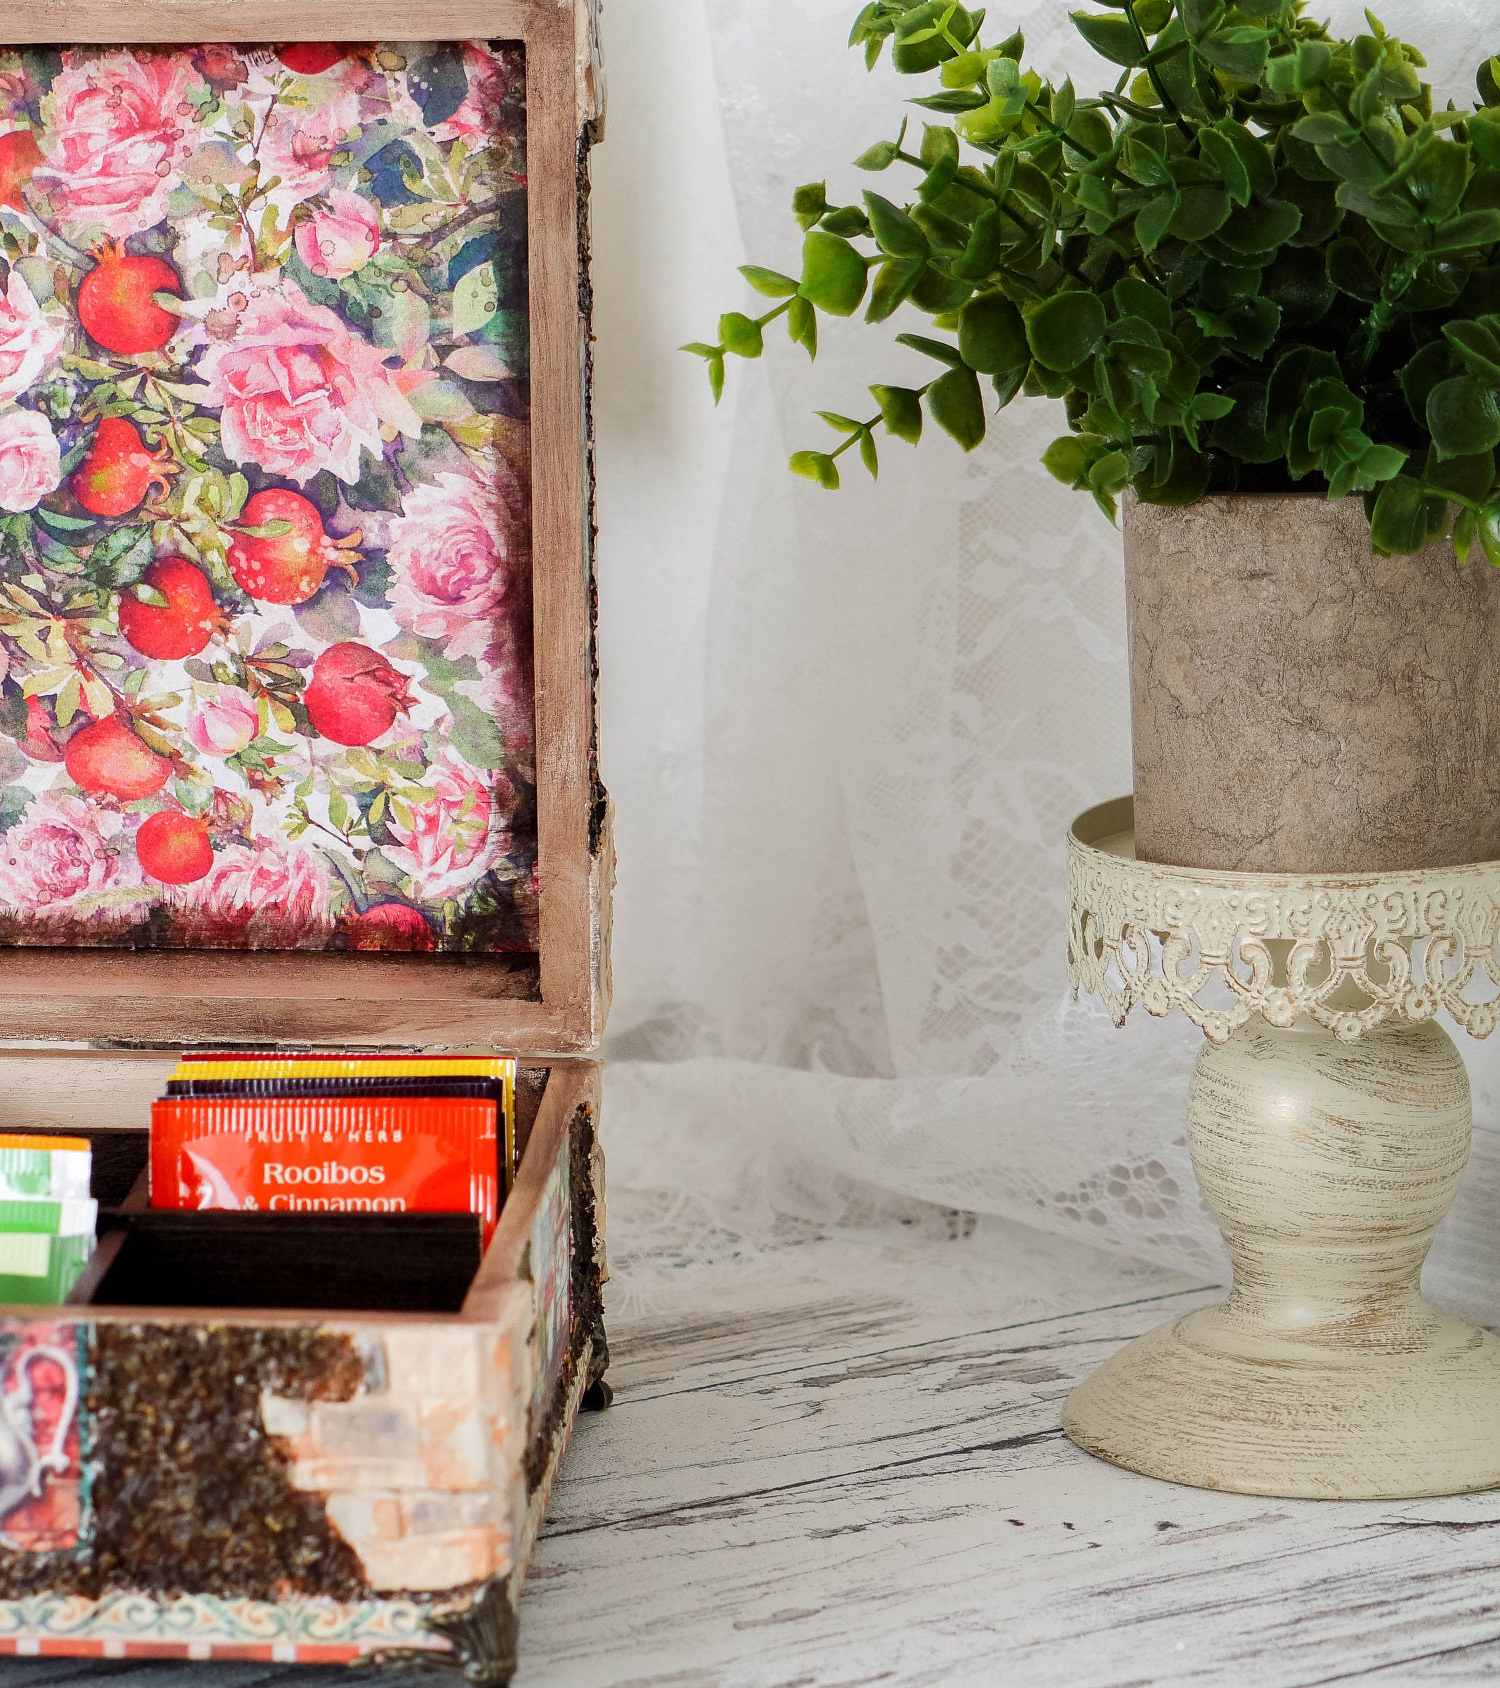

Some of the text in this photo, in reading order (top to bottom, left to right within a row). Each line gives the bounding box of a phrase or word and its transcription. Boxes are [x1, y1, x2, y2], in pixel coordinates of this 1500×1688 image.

[245, 1130, 308, 1144] FRUIT
[348, 1130, 403, 1144] HERB
[263, 1162, 386, 1185] Rooibos
[269, 1193, 406, 1212] Cinnamon
